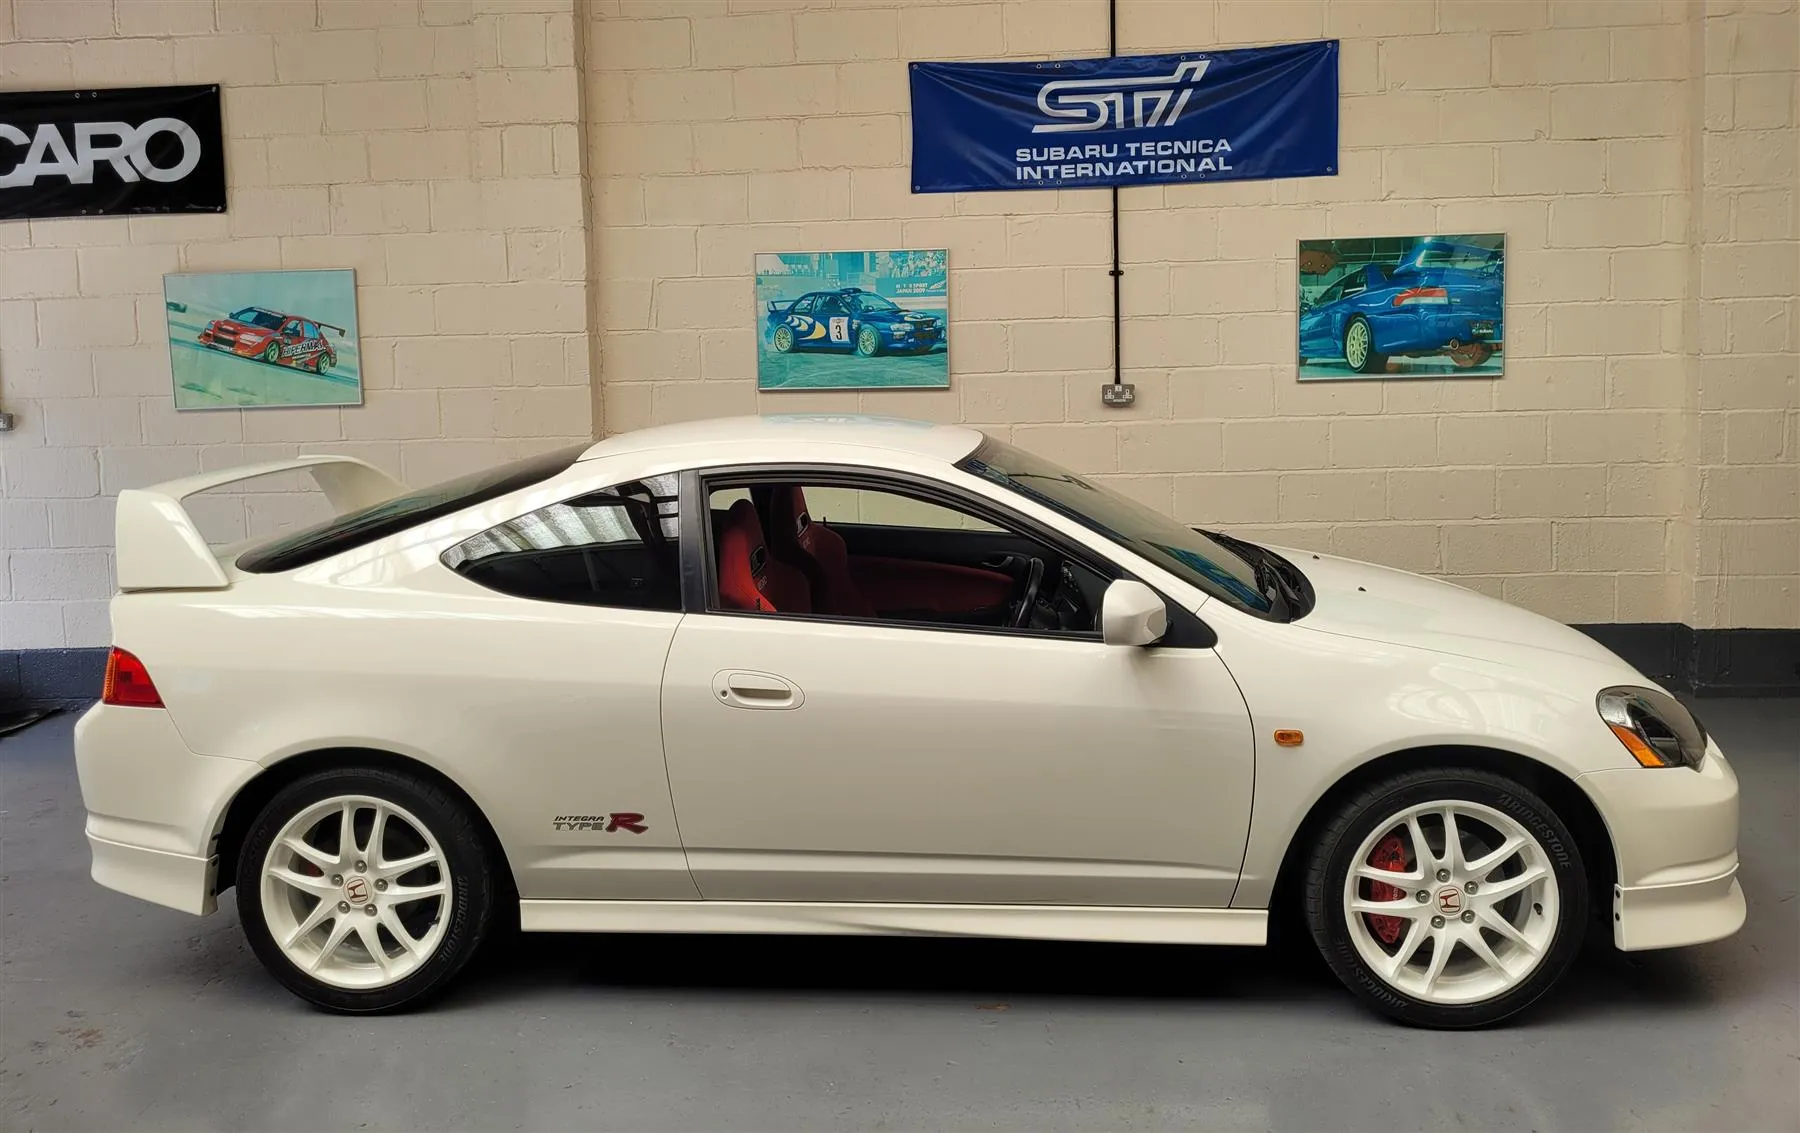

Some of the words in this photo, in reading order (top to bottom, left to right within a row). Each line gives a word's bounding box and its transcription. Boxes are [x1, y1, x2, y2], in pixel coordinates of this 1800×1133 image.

[1015, 143, 1118, 162] SUBARU
[1125, 138, 1232, 157] TECNICA
[1015, 157, 1233, 180] INTERNATIONAL
[835, 324, 843, 340] 3
[553, 822, 604, 831] TYPE
[605, 812, 649, 835] R
[1500, 793, 1572, 869] BRIDGESTONE
